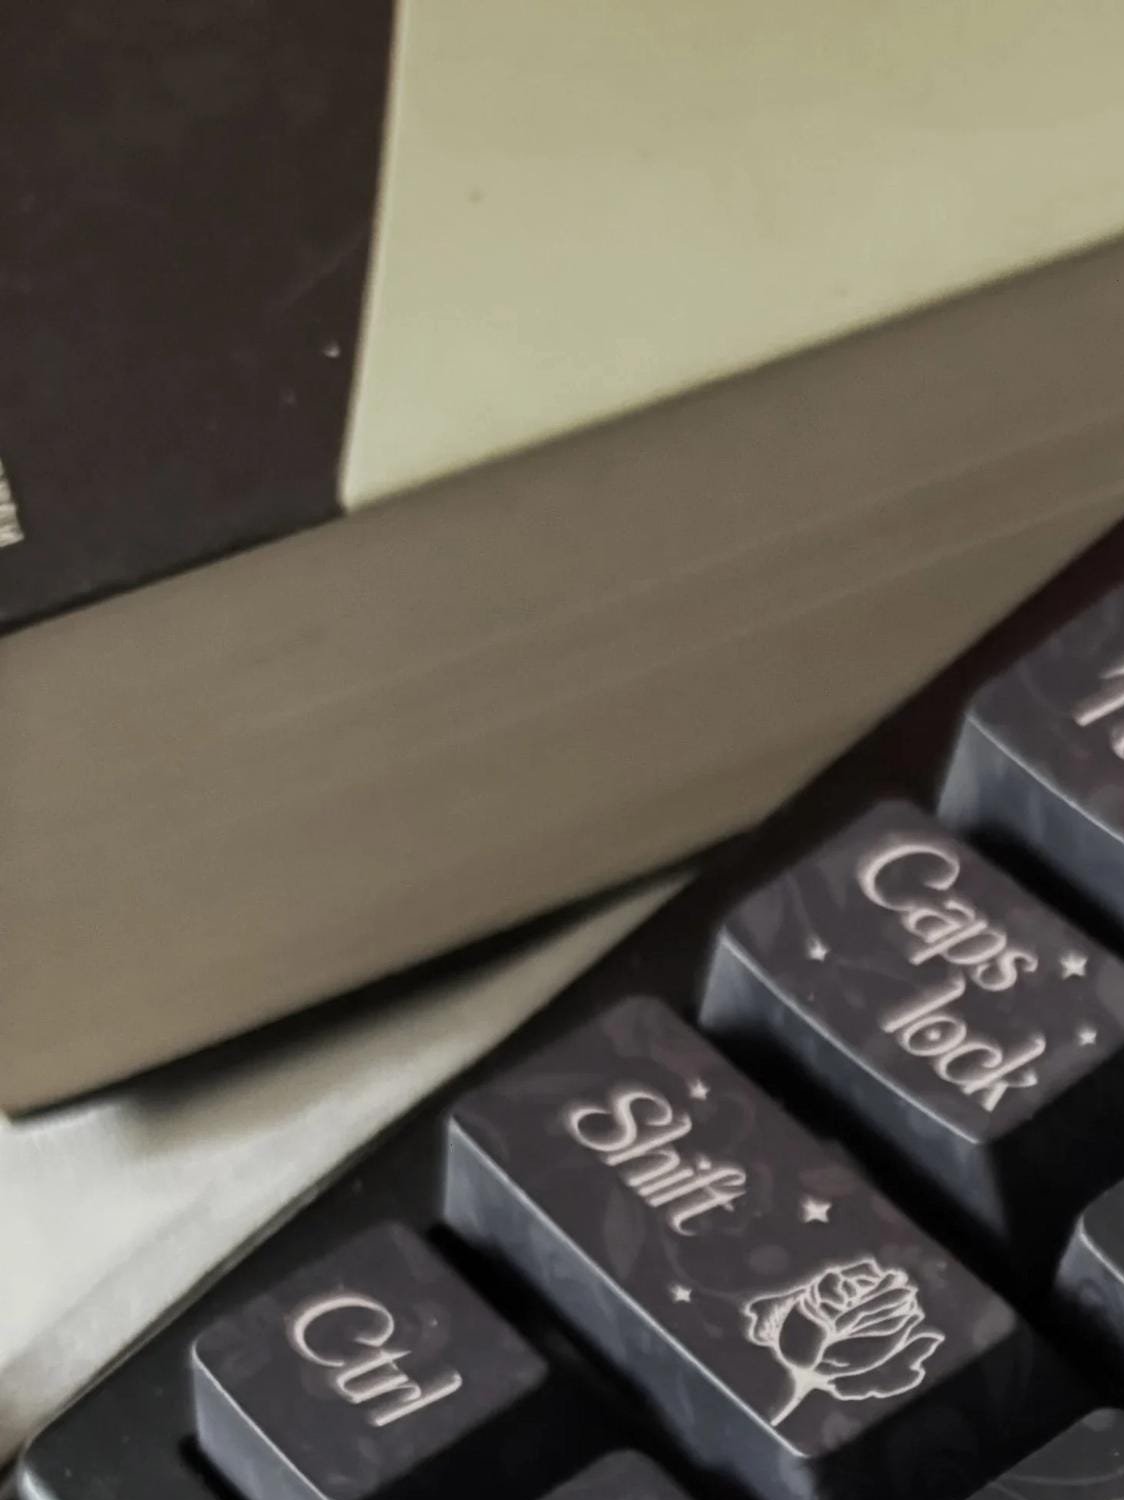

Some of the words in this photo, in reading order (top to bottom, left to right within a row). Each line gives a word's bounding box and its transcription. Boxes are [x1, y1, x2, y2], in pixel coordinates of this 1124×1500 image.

[857, 842, 1038, 992] Caps
[565, 1089, 748, 1237] Shift
[291, 1293, 463, 1428] Ctrl
